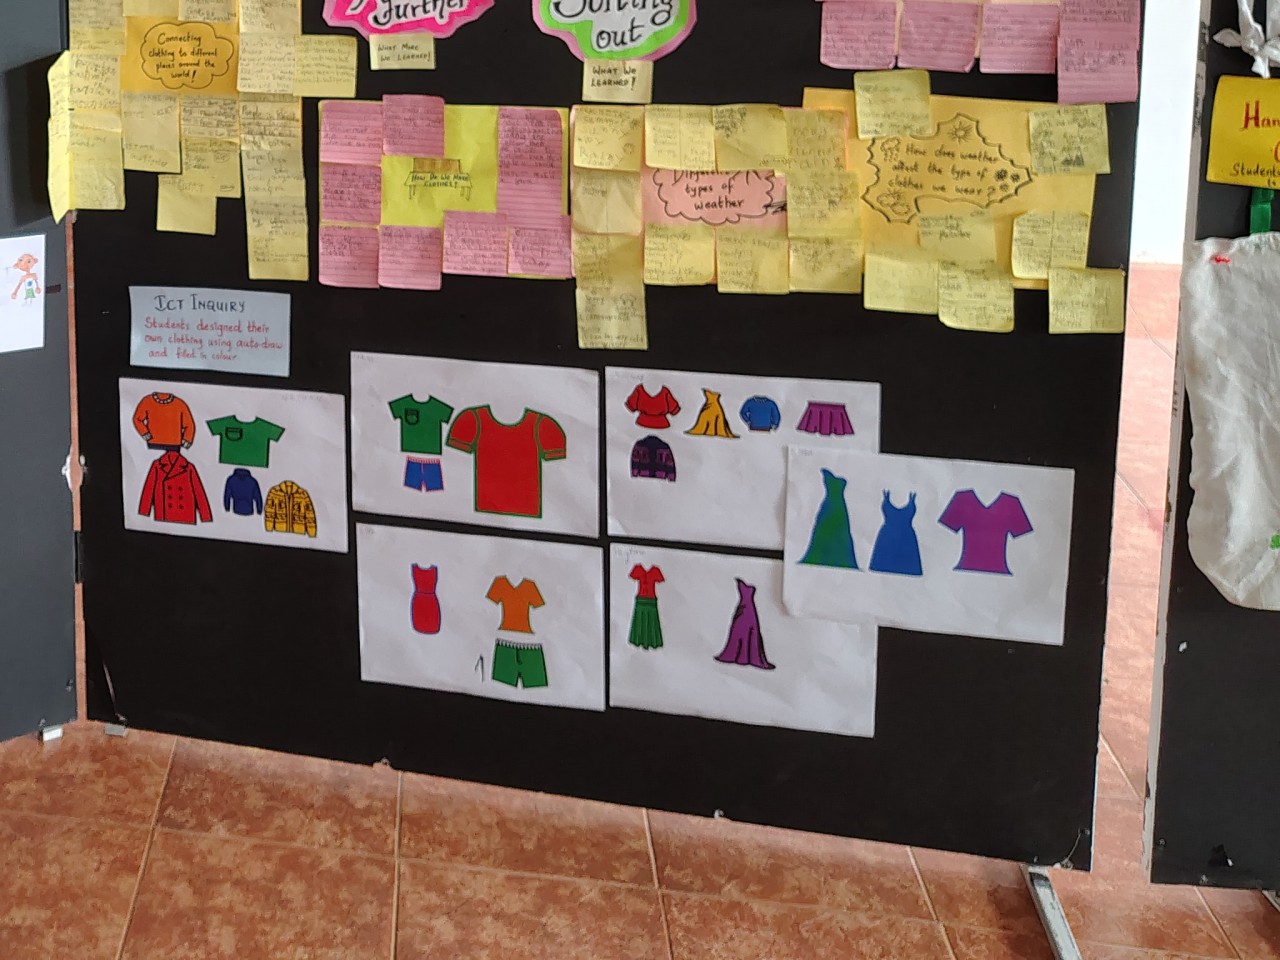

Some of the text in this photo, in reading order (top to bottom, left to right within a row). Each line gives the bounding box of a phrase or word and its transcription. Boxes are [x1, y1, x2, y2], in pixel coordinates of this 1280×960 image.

[158, 32, 201, 46] Connecting
[596, 17, 644, 49] out
[149, 48, 217, 62] clothing to different
[156, 61, 174, 73] places
[906, 143, 998, 163] How does weather
[928, 162, 942, 175] the
[951, 164, 970, 180] type
[977, 167, 987, 182] of
[686, 182, 733, 198] types of
[888, 175, 922, 189] clothes
[694, 195, 744, 210] weather
[154, 294, 245, 313] ICT INQUIRY
[145, 317, 269, 336] Students designed their
[145, 334, 163, 342] own
[168, 333, 203, 349] clothing
[208, 340, 231, 353] using
[149, 347, 167, 357] and
[176, 347, 196, 359] filled
